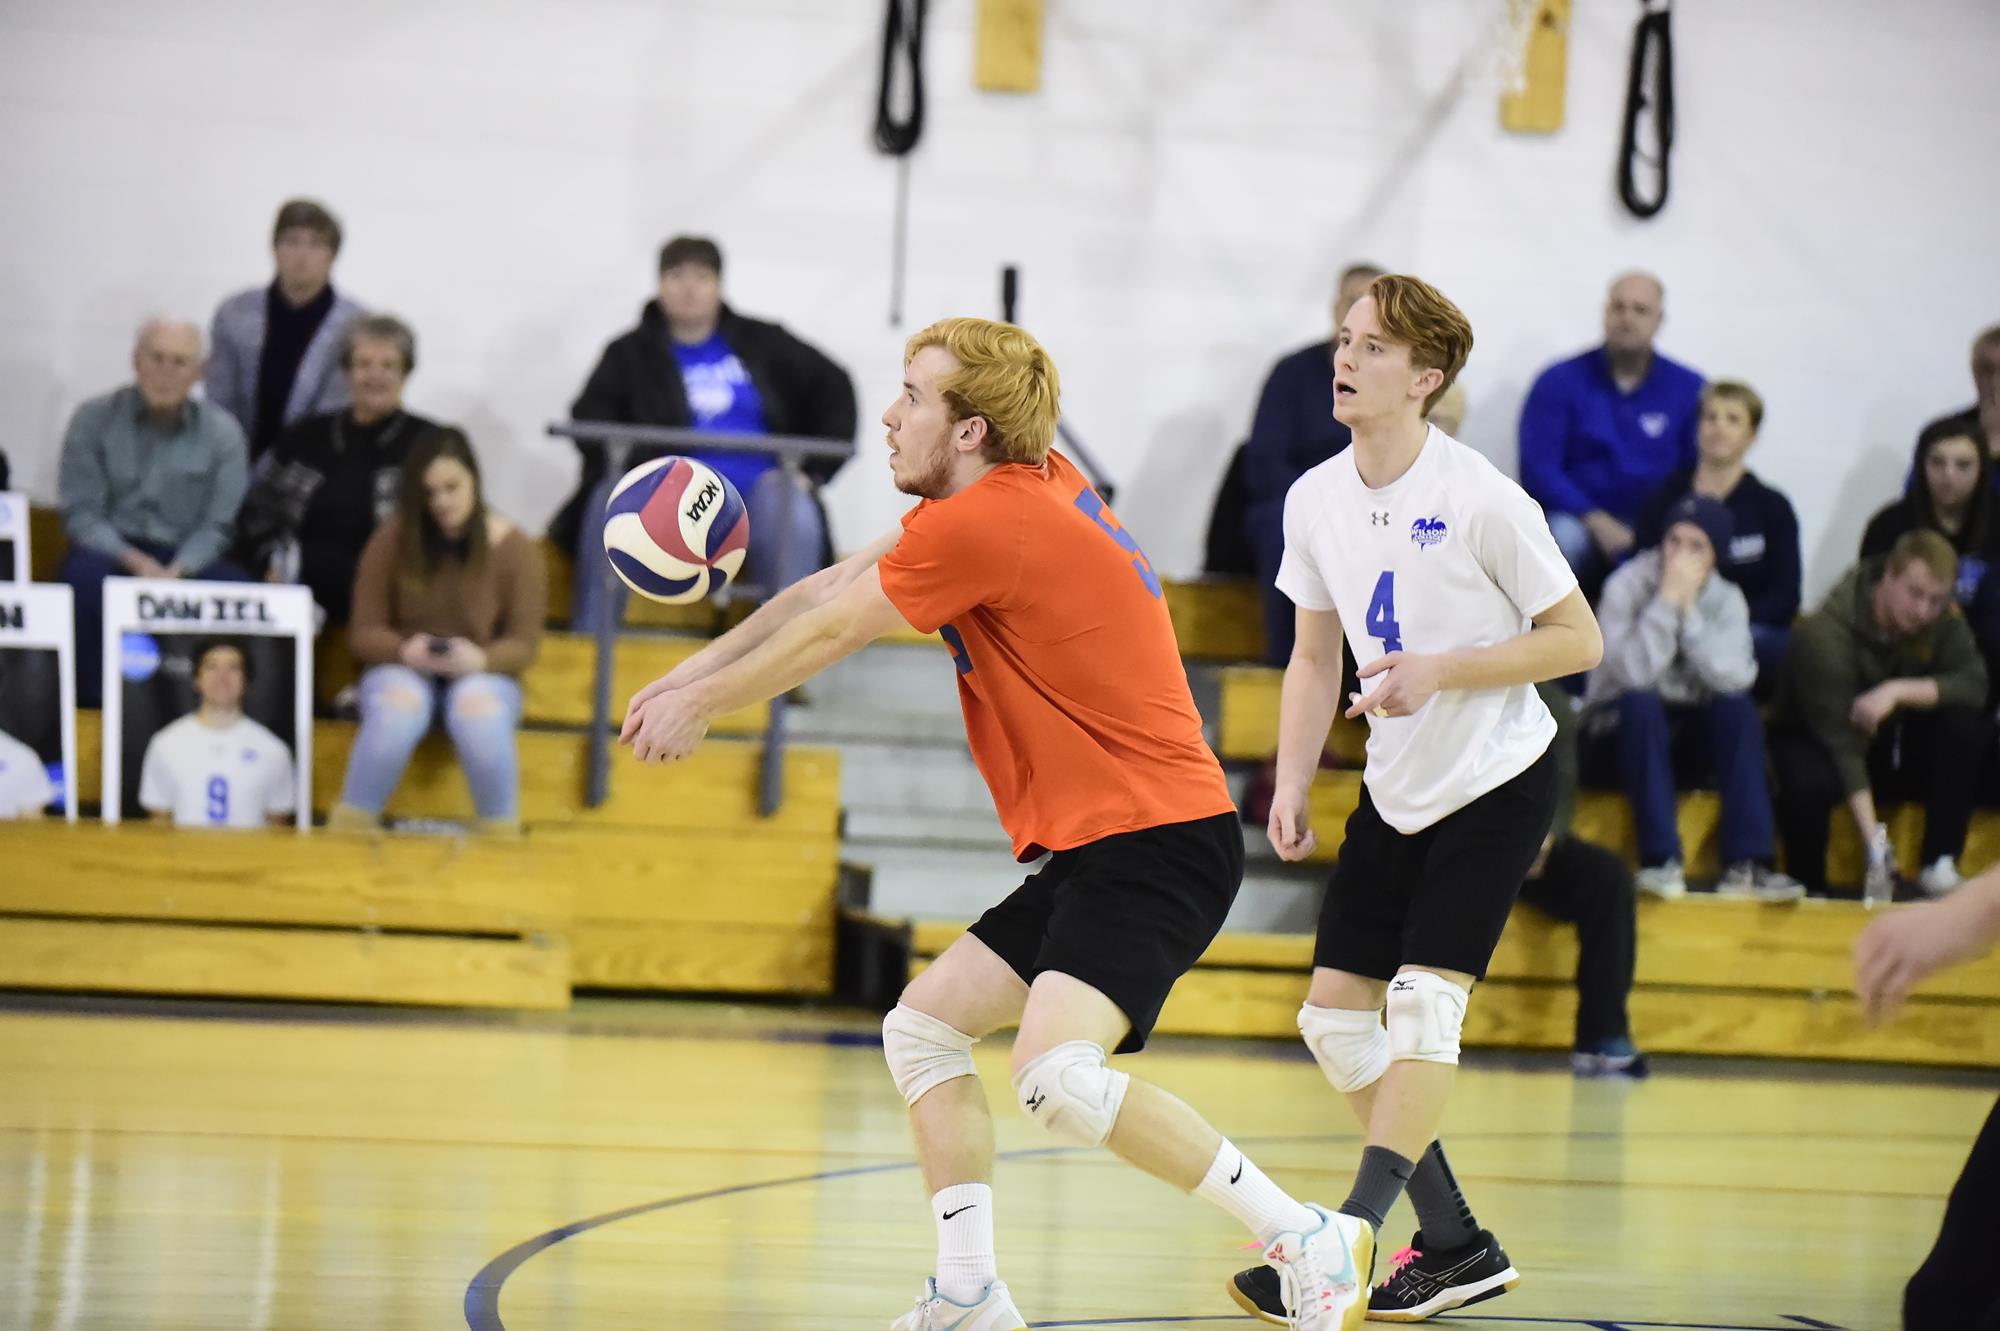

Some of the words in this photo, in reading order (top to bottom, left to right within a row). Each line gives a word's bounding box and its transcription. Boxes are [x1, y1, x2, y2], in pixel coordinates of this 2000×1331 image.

[686, 480, 720, 522] NCAA
[1411, 528, 1447, 537] WILSON
[138, 593, 275, 623] DANIEL
[1366, 570, 1403, 655] 4
[207, 775, 230, 823] 9
